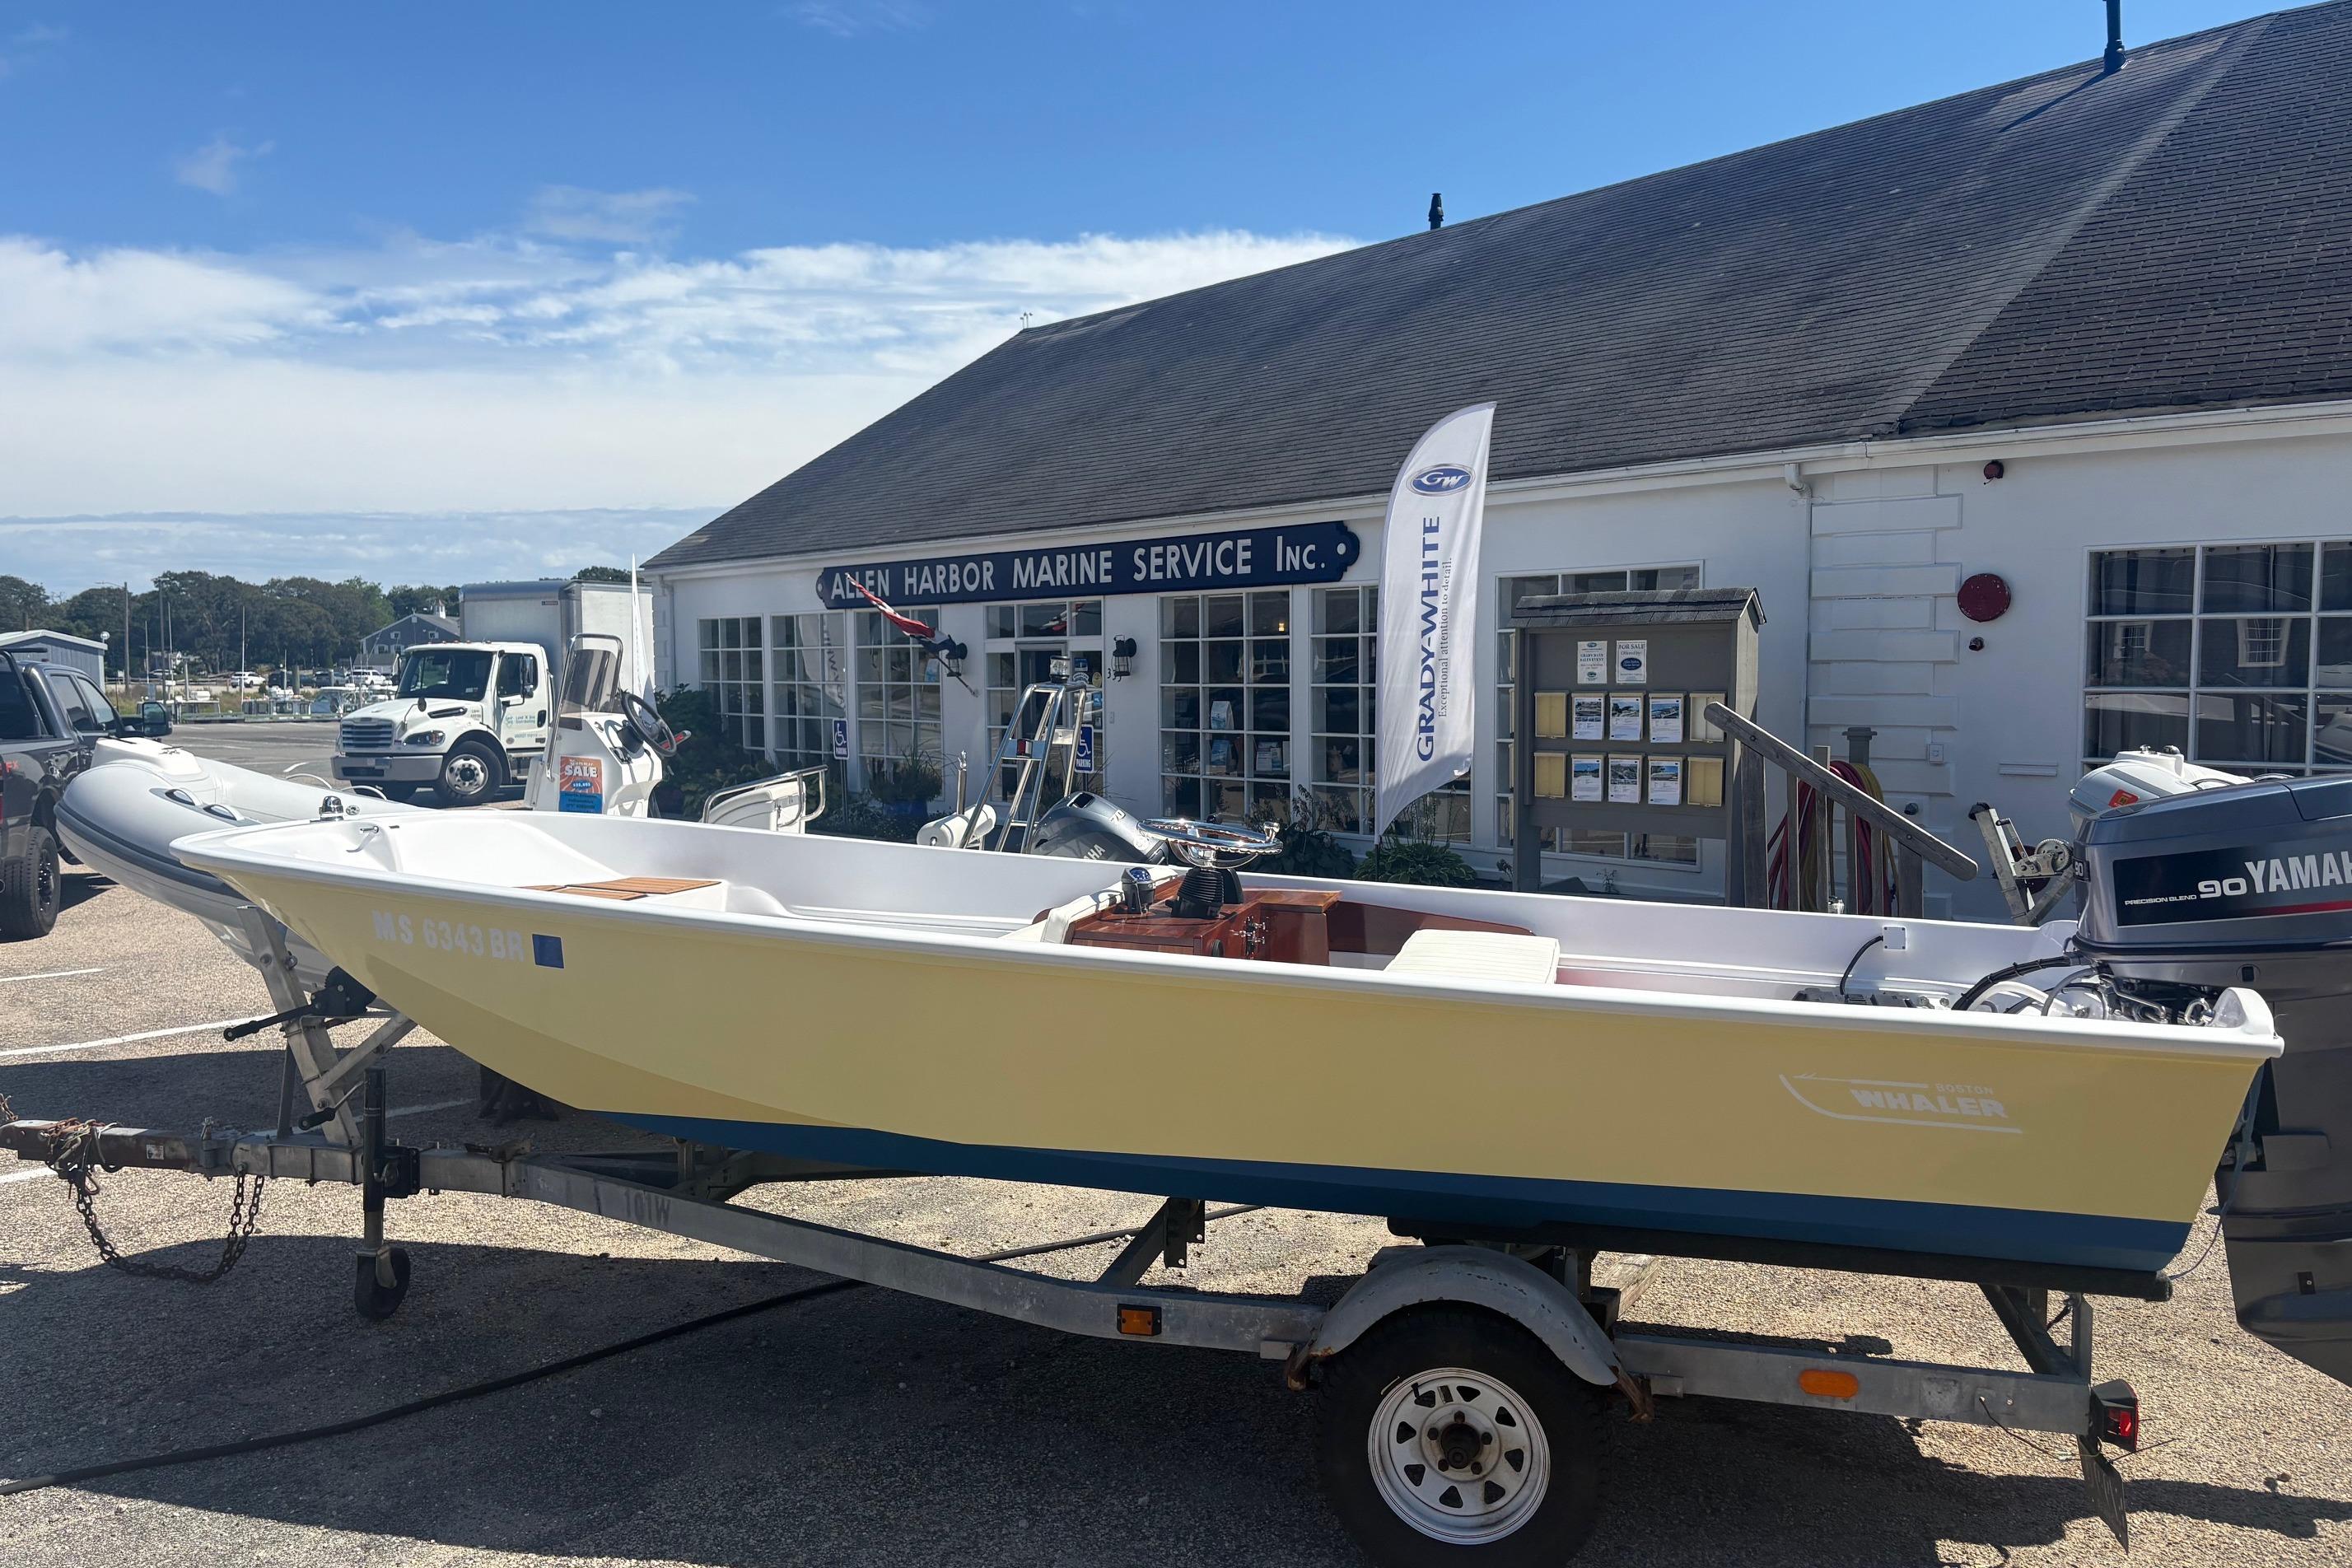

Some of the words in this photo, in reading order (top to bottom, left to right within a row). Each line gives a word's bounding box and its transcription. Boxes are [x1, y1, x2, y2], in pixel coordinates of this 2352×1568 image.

[830, 569, 889, 600] ALLEN
[904, 561, 995, 595] HARBOR
[1012, 550, 1112, 589] MARINE
[1133, 539, 1252, 581] SERVICE
[1442, 594, 1449, 604] to
[1416, 516, 1440, 762] GRADY-WHITE
[1440, 608, 1449, 656] attention
[1438, 658, 1450, 717] Exceptional
[565, 764, 599, 778] SALE
[1108, 810, 1127, 824] 70
[2124, 897, 2168, 906] PRECISION
[2198, 877, 2247, 898] 90
[371, 909, 414, 945] MS
[422, 917, 484, 957] 6343
[489, 927, 525, 962] BR
[1850, 1089, 2009, 1118] WHALER
[1936, 1083, 1995, 1095] BOSTON
